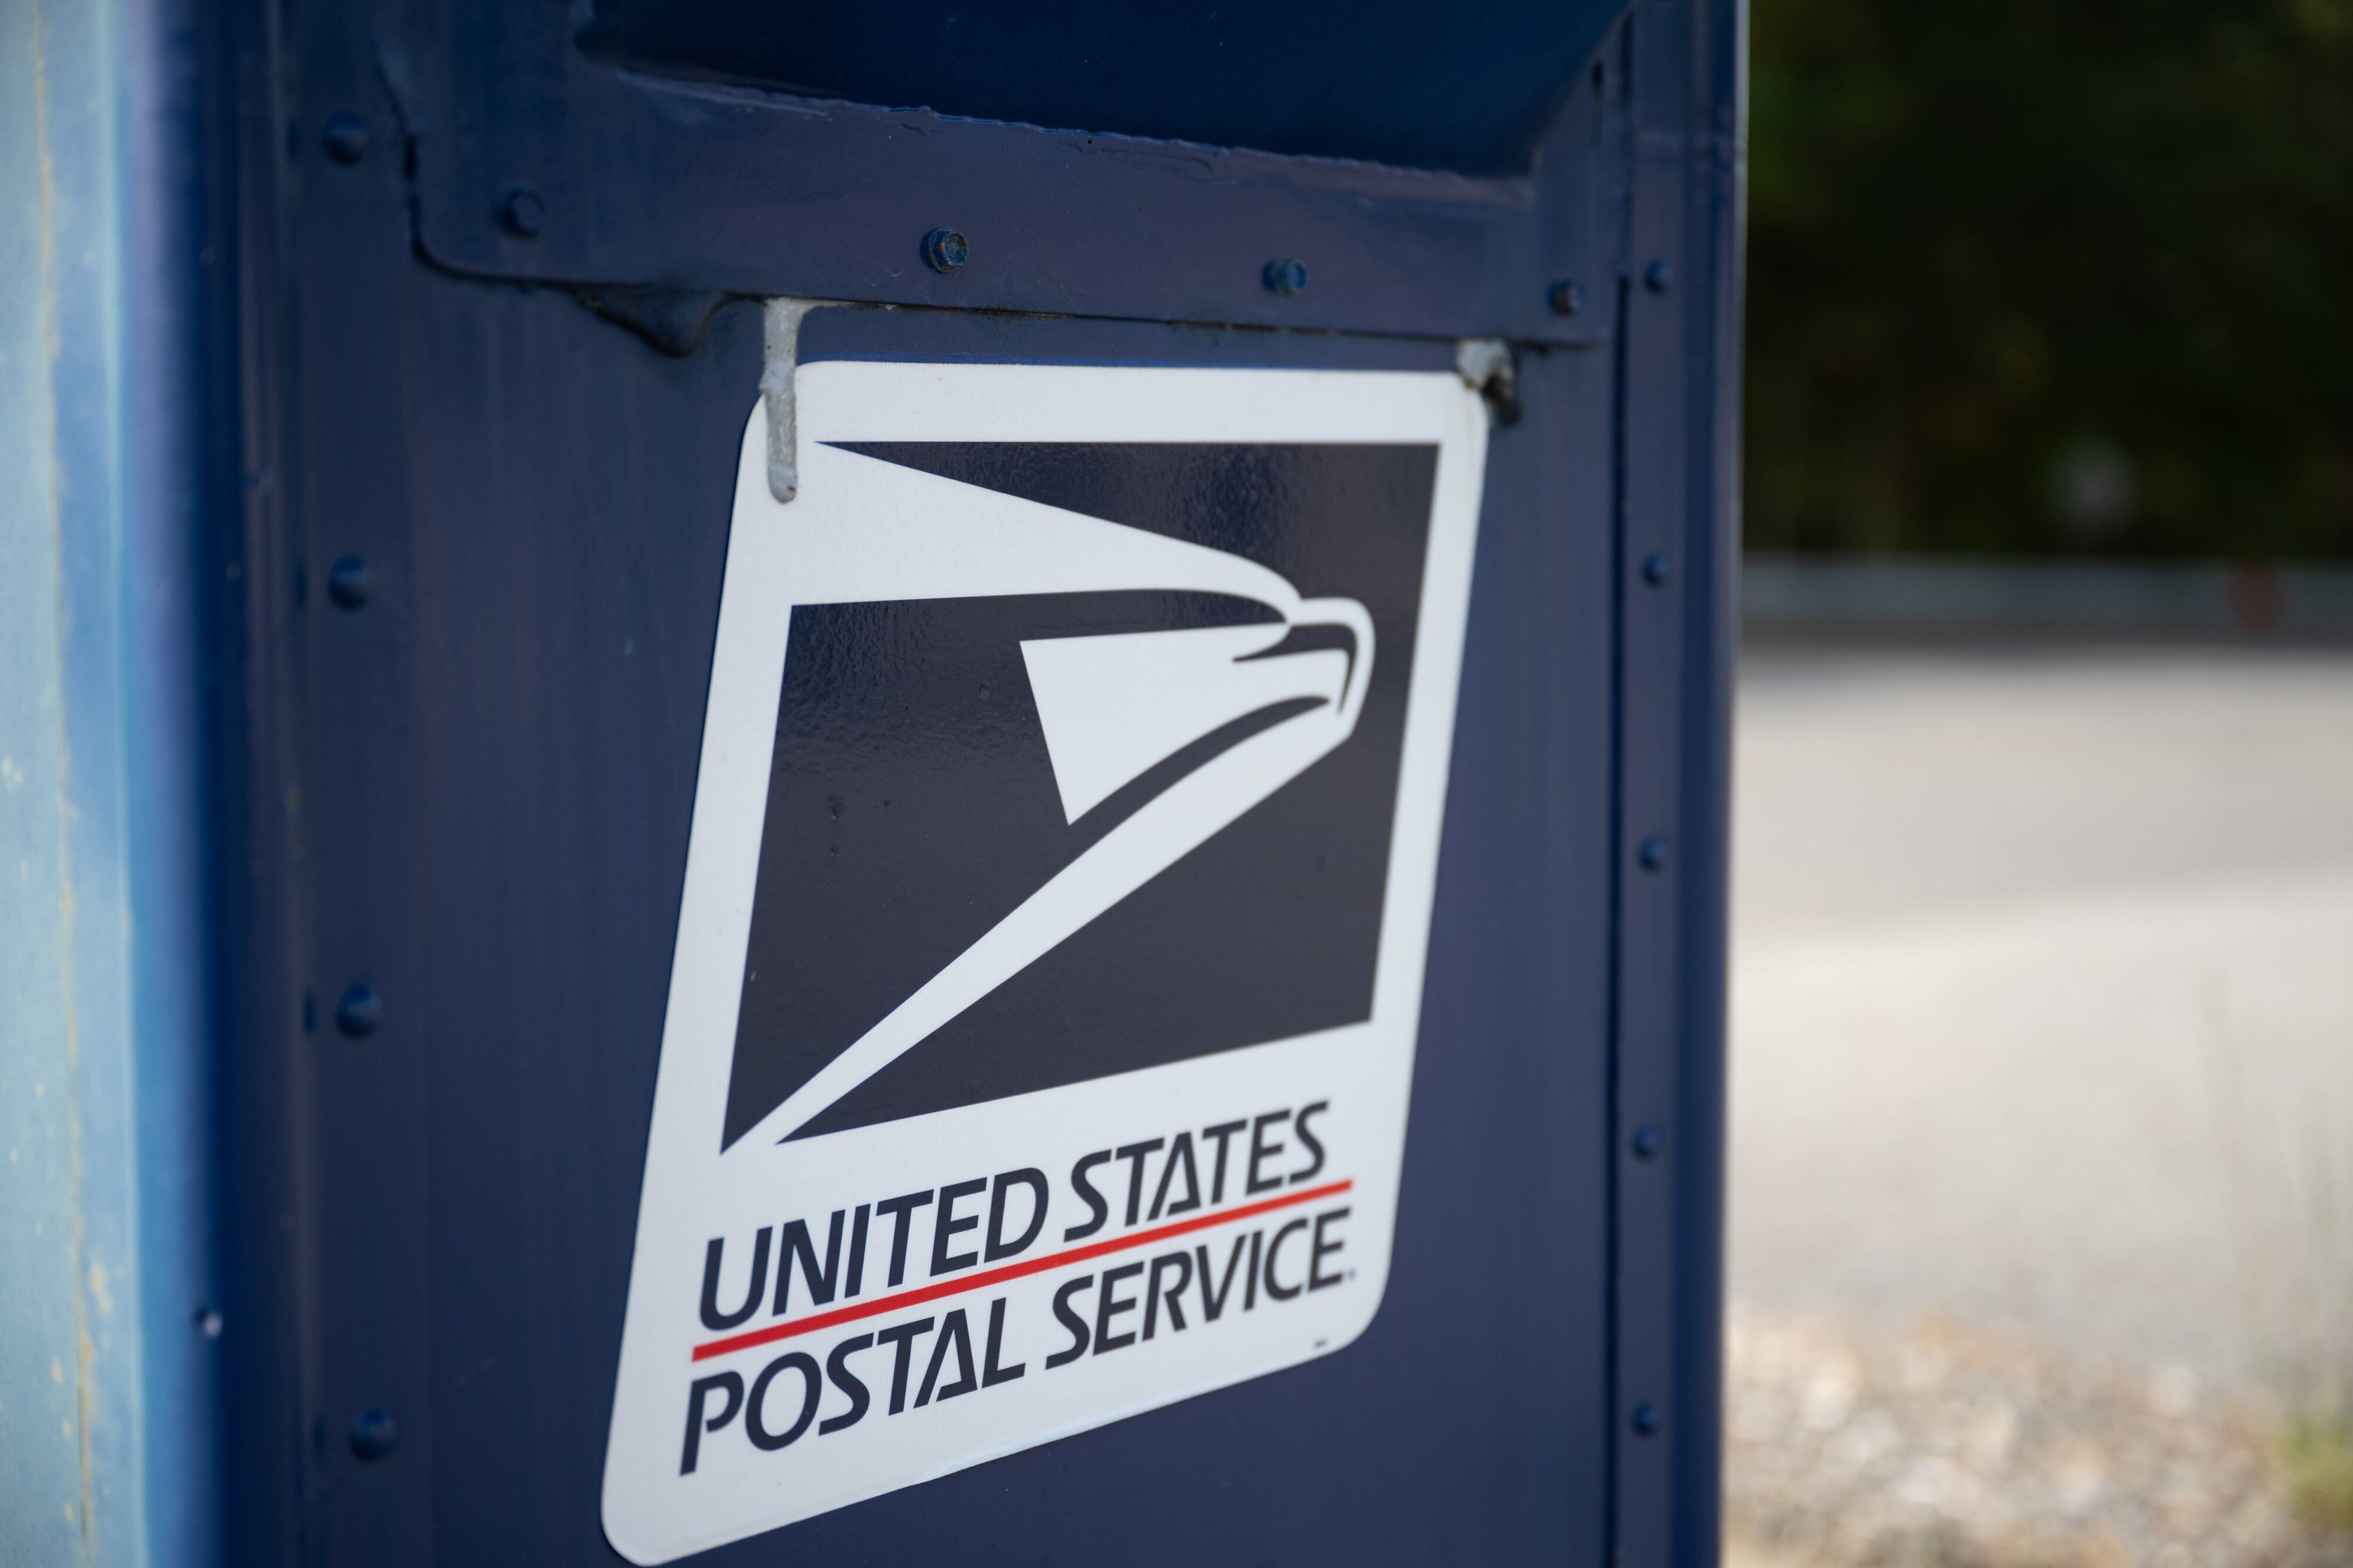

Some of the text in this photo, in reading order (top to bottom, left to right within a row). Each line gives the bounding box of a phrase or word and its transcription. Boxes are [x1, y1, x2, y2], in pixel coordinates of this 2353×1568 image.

[699, 1100, 1328, 1332] UNITED STATES
[679, 1207, 1351, 1476] POSTAL SERVICE
